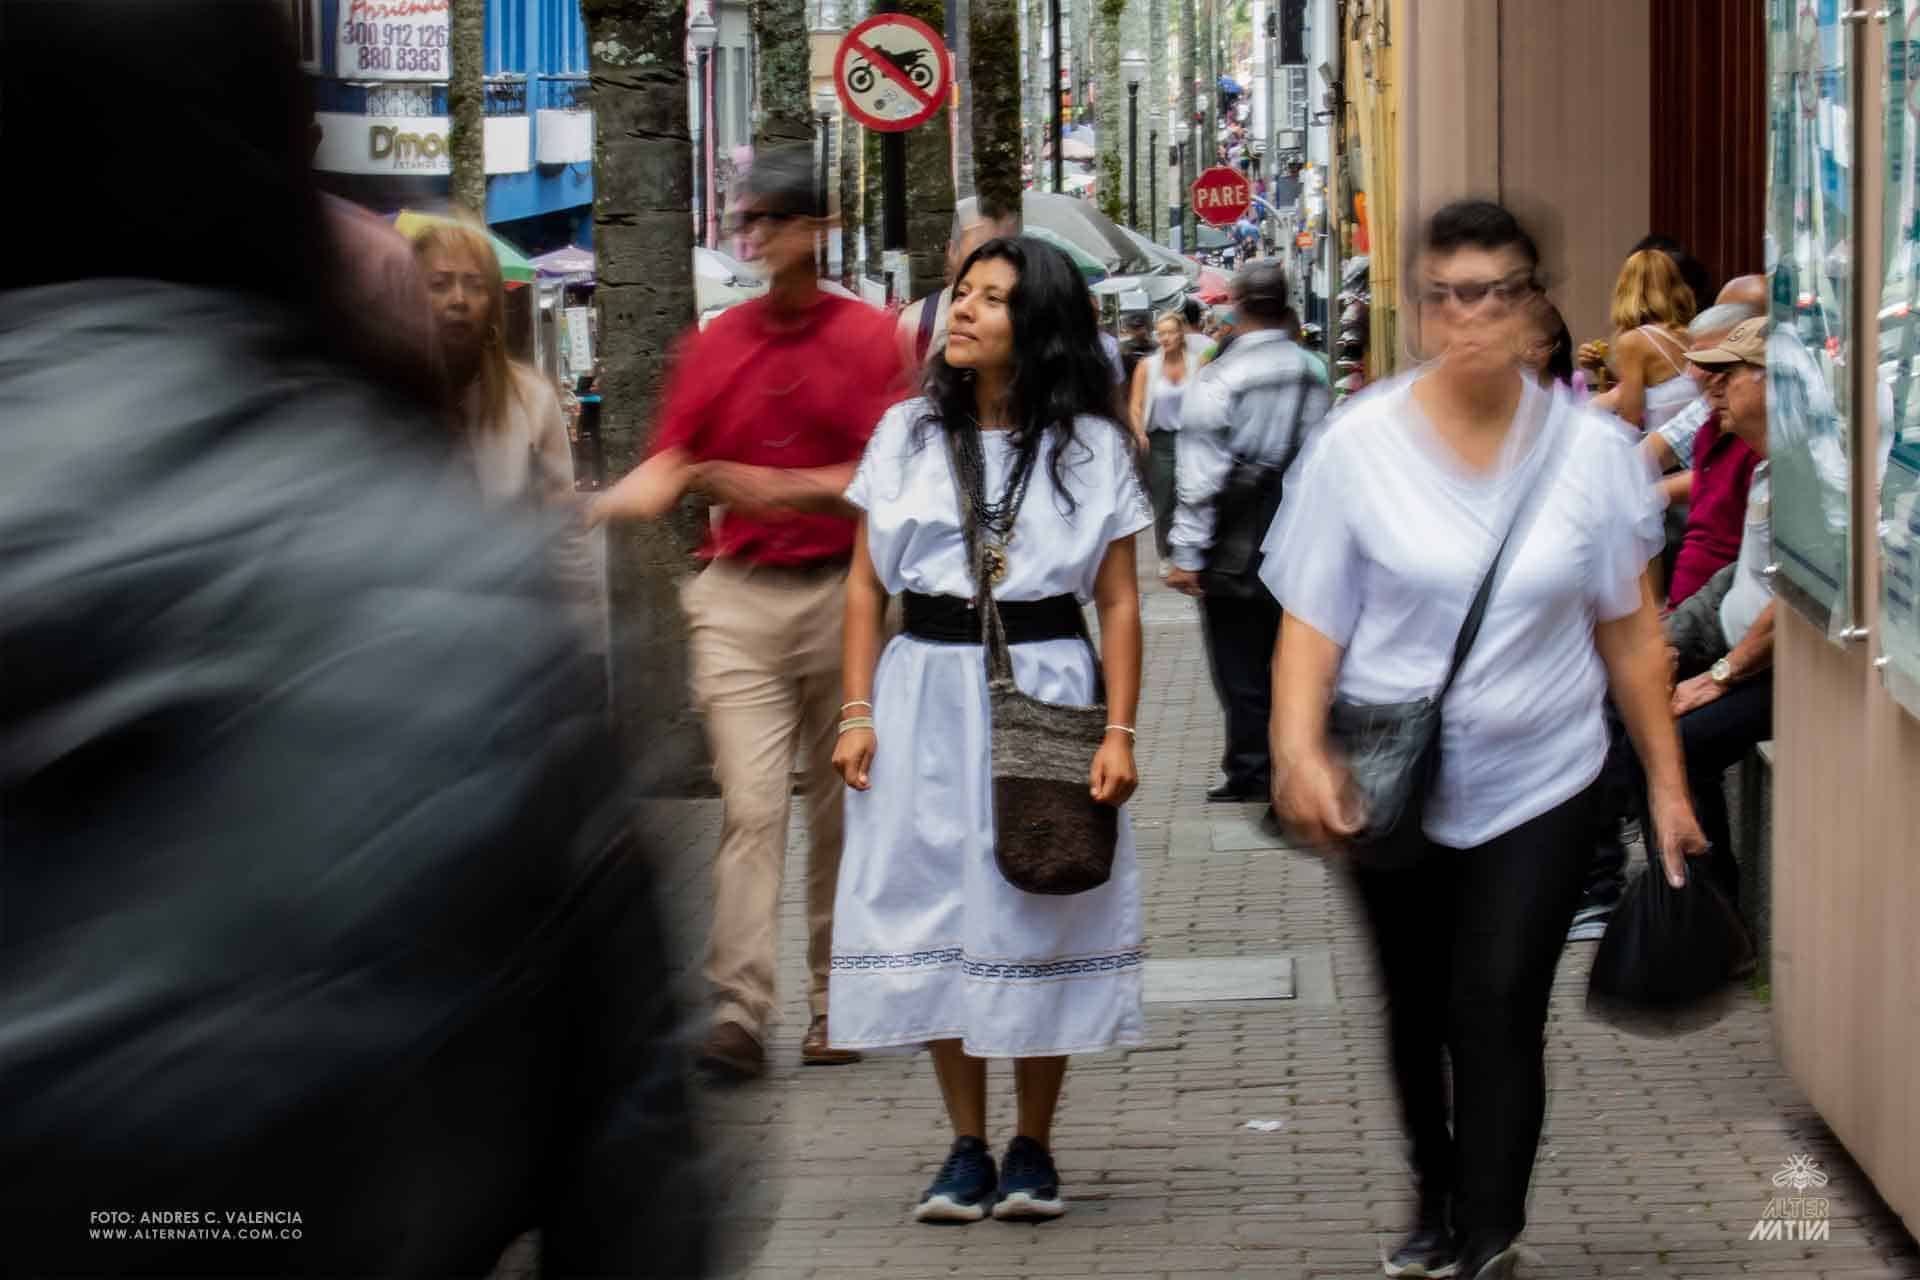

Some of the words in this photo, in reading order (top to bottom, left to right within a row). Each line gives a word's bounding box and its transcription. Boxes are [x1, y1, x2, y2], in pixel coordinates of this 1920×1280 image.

[343, 20, 378, 46] 300
[382, 23, 413, 47] 912
[416, 25, 449, 48] 126
[358, 46, 391, 70] 880
[397, 47, 441, 72] 8383
[1197, 184, 1246, 209] PARE
